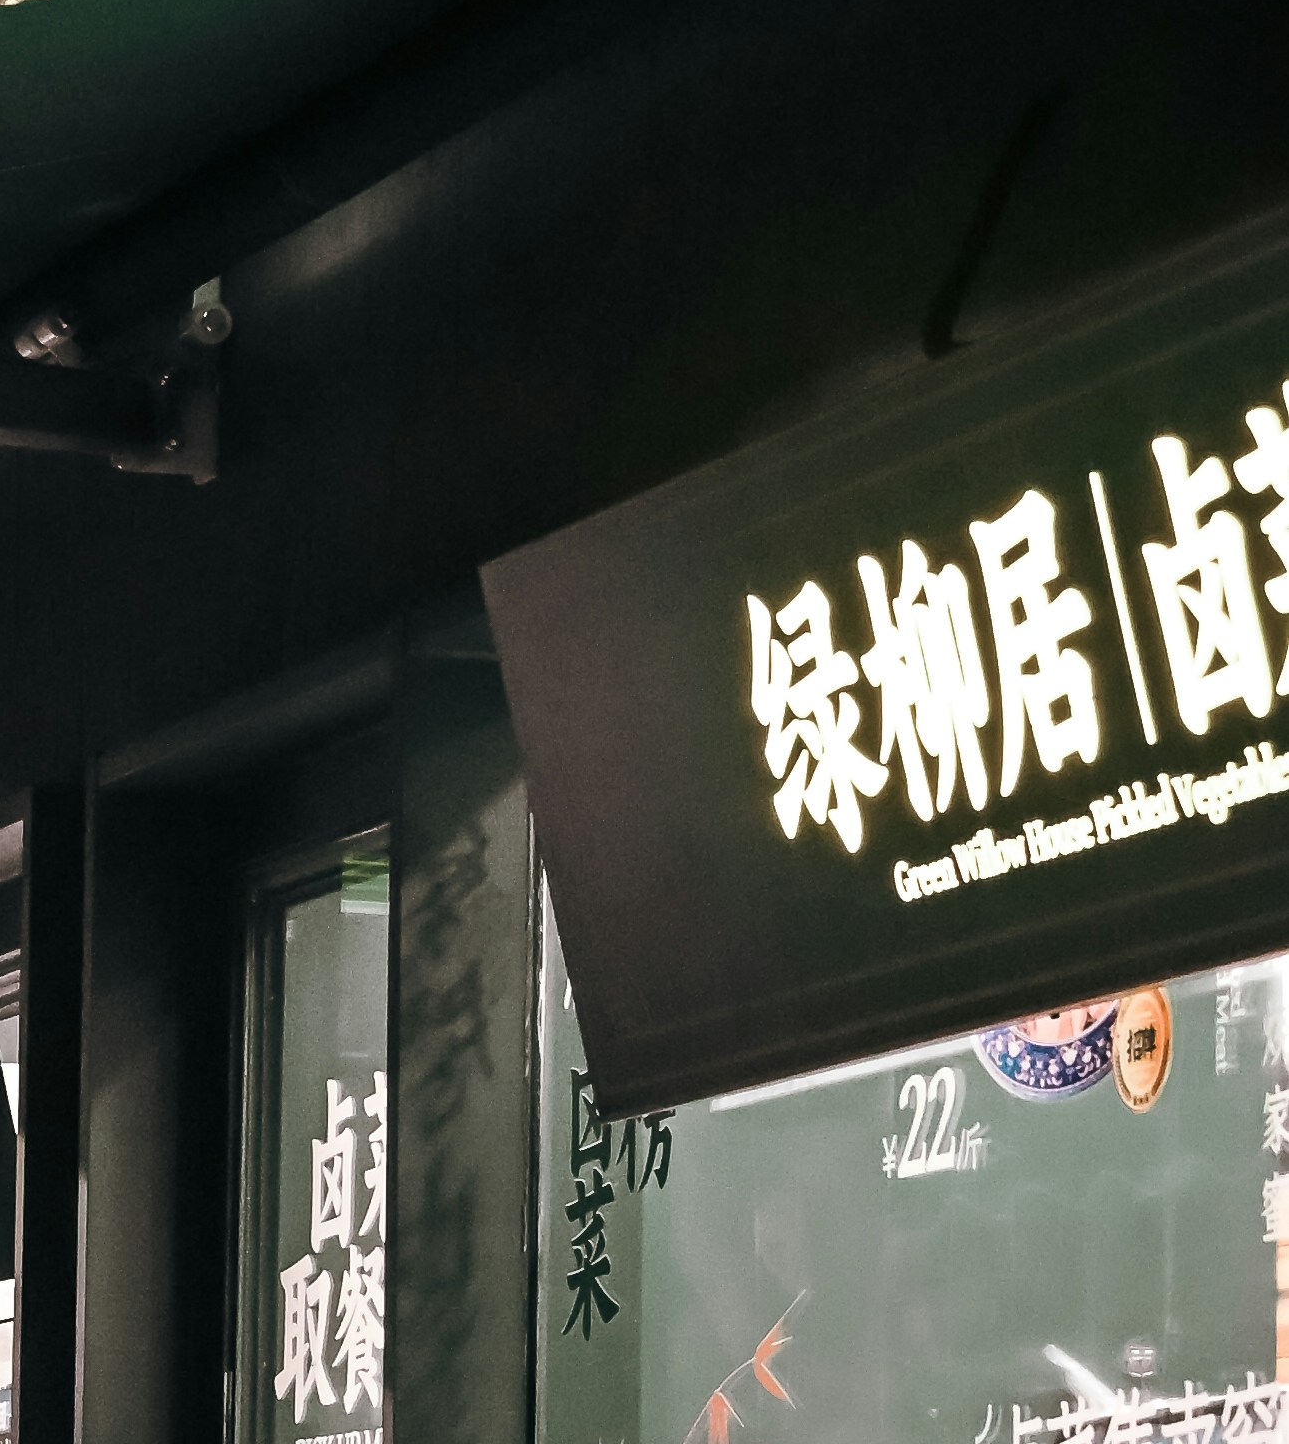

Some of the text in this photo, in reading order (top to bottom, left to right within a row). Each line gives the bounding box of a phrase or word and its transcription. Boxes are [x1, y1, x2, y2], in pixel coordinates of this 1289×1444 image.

[745, 488, 1103, 854] 绿柳居
[893, 858, 960, 903] Green
[951, 827, 1027, 884] Willow
[1023, 818, 1097, 864] House
